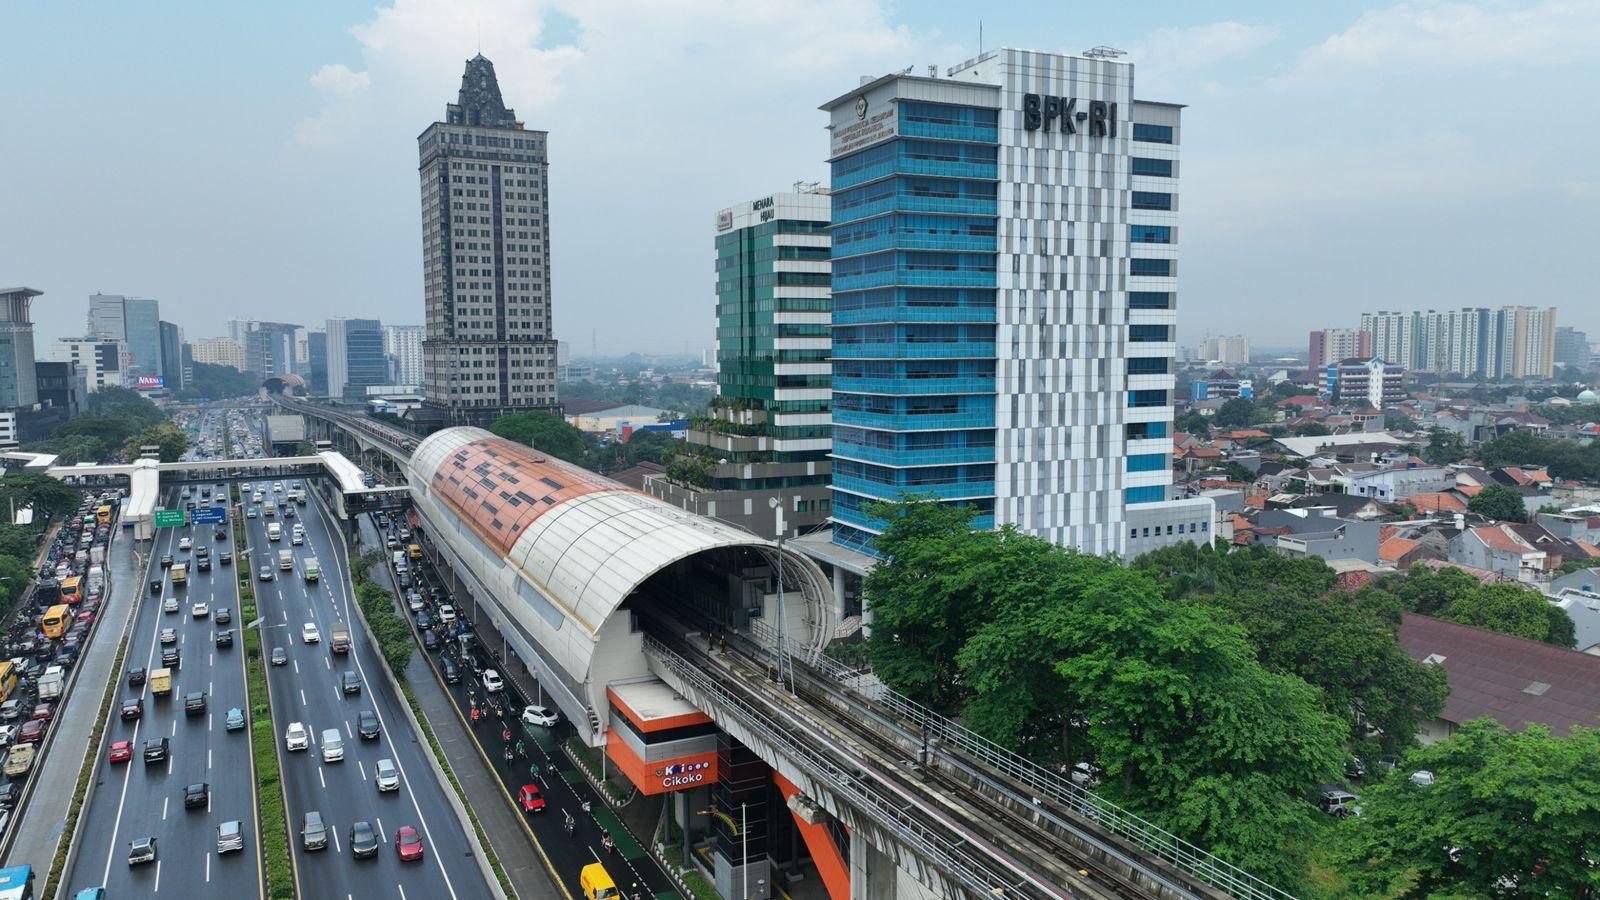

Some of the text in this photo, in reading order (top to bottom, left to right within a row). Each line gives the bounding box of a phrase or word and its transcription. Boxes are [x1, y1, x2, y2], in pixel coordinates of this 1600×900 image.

[1024, 94, 1117, 138] BPK-RI
[753, 196, 774, 211] MENARA
[760, 209, 774, 222] HIJAU
[662, 773, 702, 787] Cikoko
